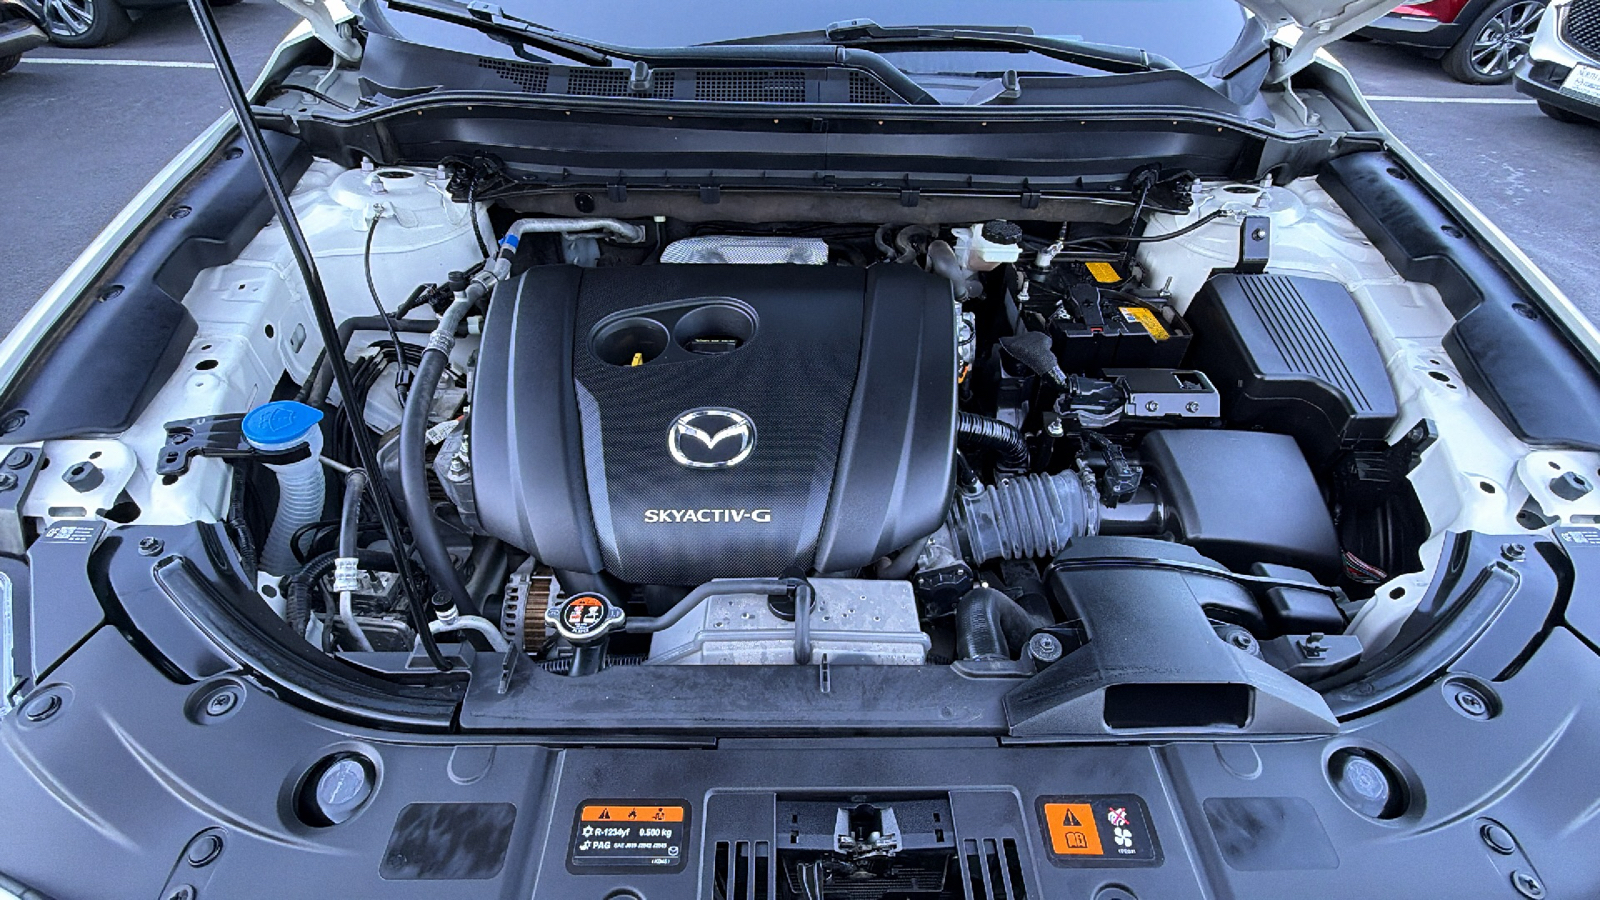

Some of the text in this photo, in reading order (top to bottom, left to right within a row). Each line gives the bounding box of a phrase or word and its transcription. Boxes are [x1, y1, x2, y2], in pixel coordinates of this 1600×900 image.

[644, 509, 771, 522] SKYACTIV-G
[594, 827, 630, 838] R-1234yf
[661, 828, 672, 838] kg
[592, 841, 610, 849] PAG
